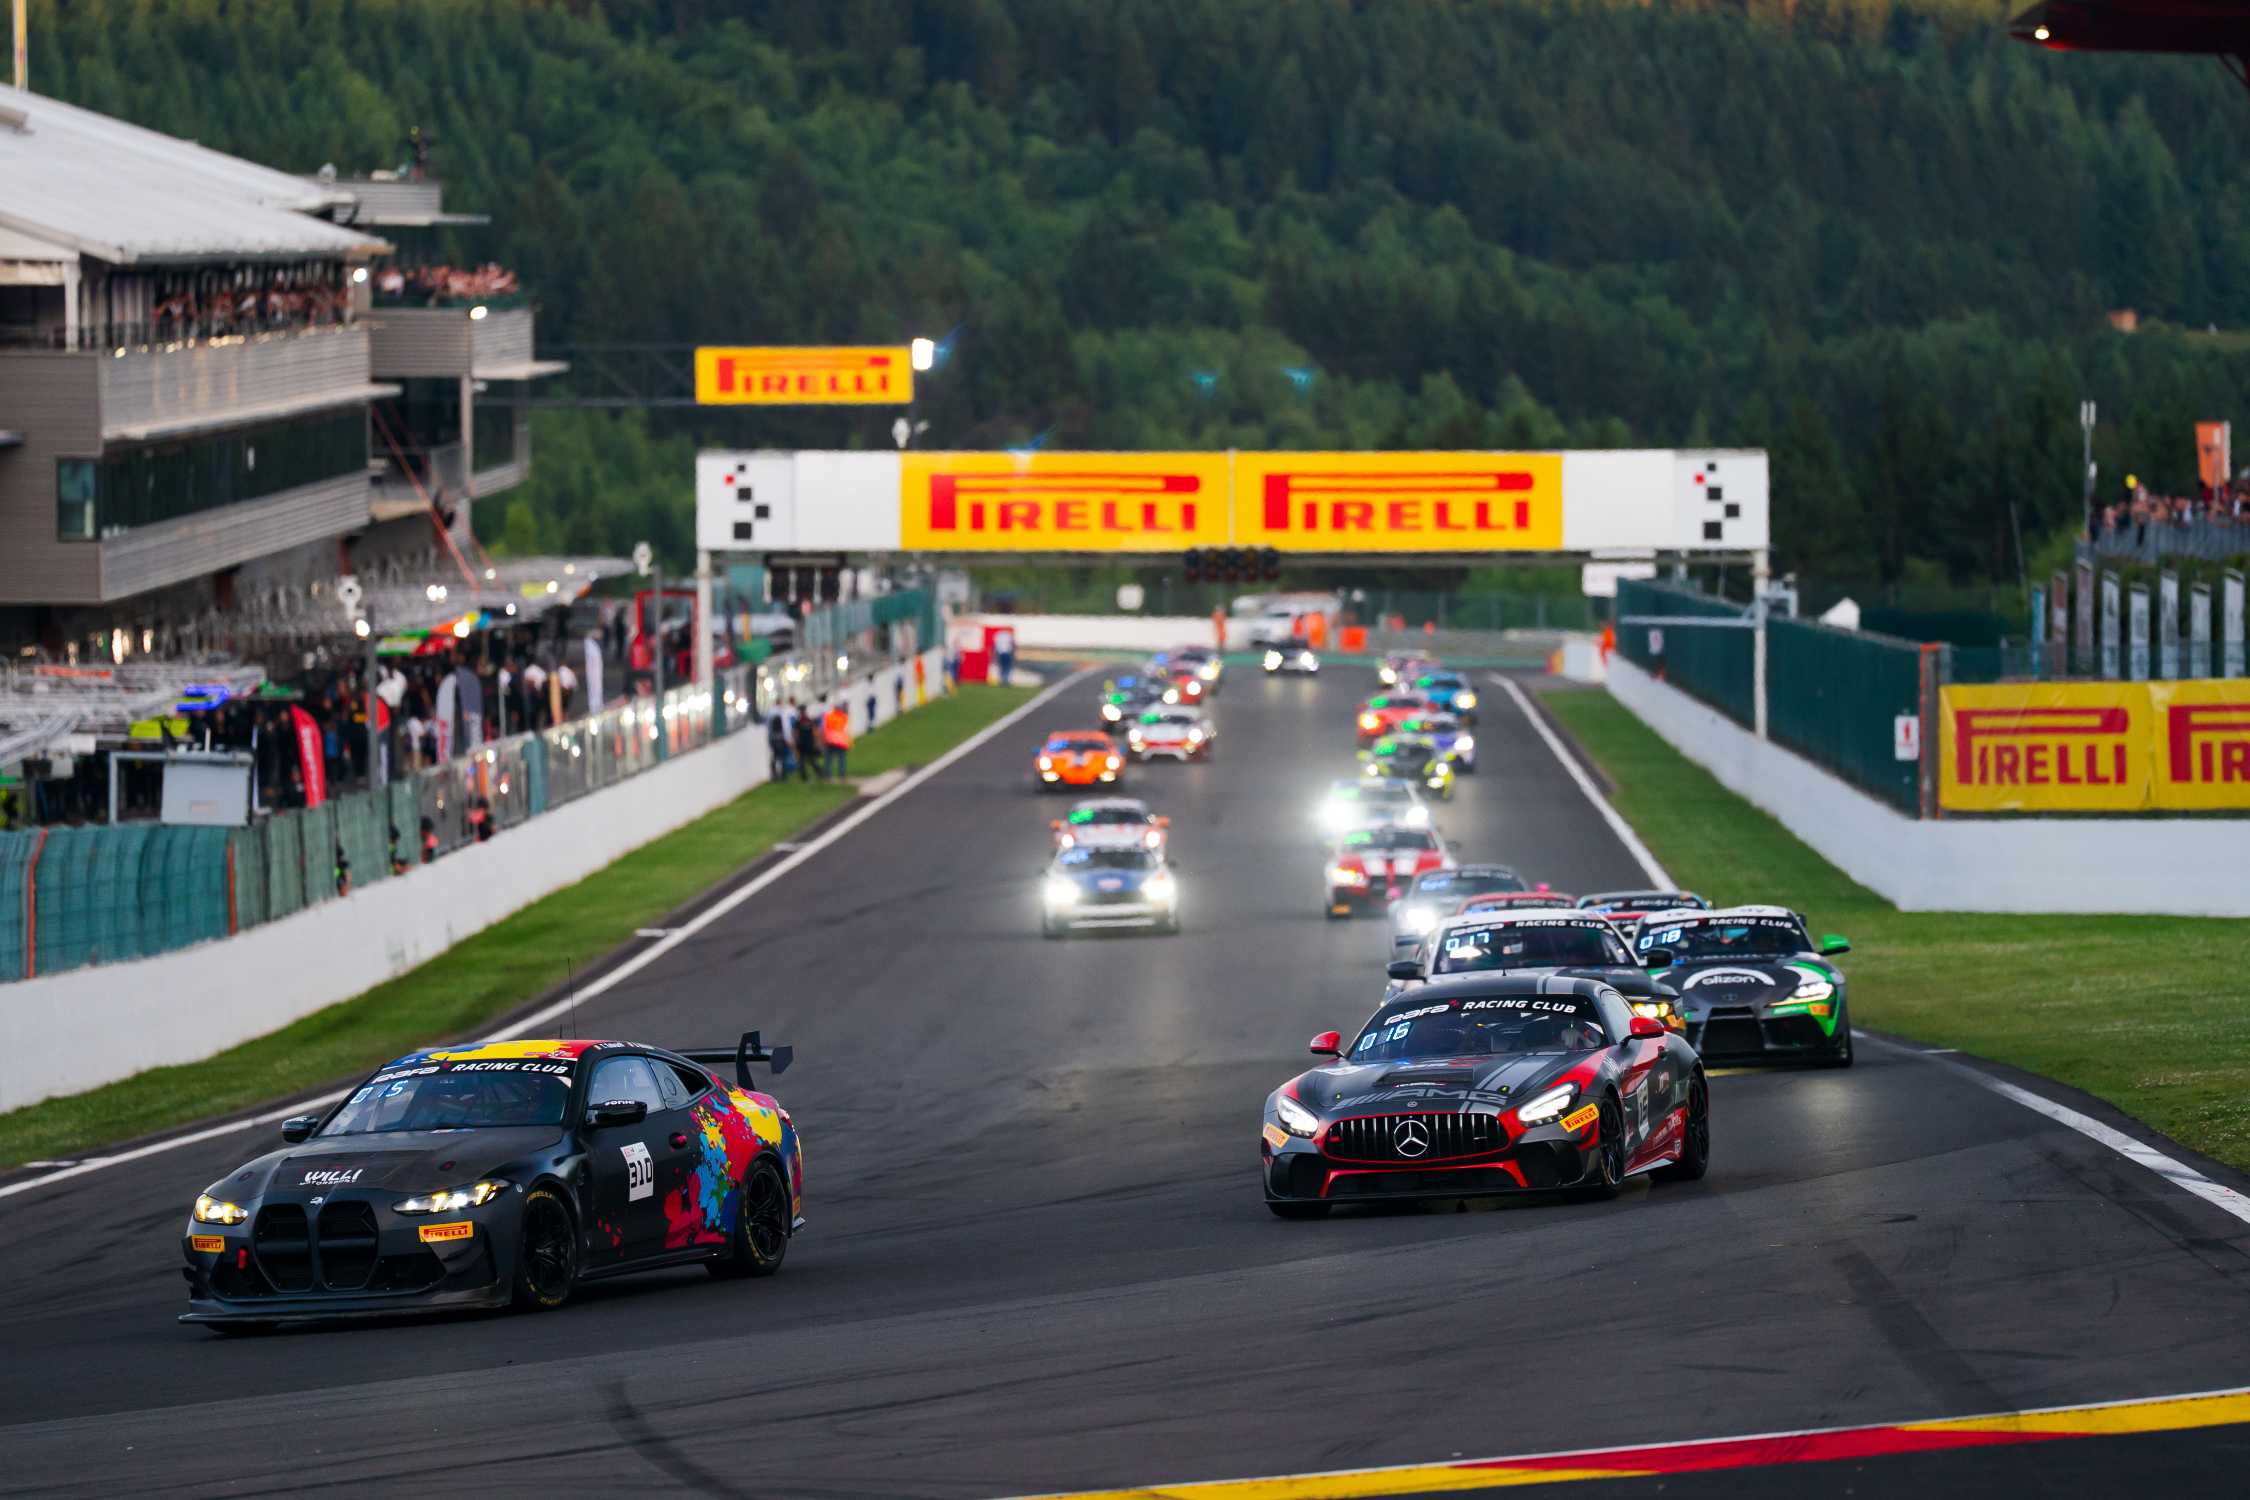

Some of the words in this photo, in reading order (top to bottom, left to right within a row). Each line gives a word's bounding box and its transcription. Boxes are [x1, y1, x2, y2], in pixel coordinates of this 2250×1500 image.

[718, 357, 890, 393] PIRELLI
[929, 473, 1200, 531] PIRELLI
[1263, 473, 1534, 531] PIRELLI
[1955, 708, 2129, 785] PIRELLI
[1515, 919, 1567, 928] RACING
[1569, 920, 1605, 930] CLUB
[1708, 917, 1757, 926] RACING
[1760, 918, 1793, 929] CLUB
[1463, 999, 1529, 1011] RACING
[1531, 1000, 1577, 1014] CLUB
[450, 1062, 517, 1072] RACING
[521, 1062, 569, 1074] CLUB
[1564, 1107, 1596, 1129] PIRELLI
[304, 1169, 363, 1183] WILLI
[629, 1157, 653, 1188] 310
[423, 1225, 468, 1239] PIRELLI
